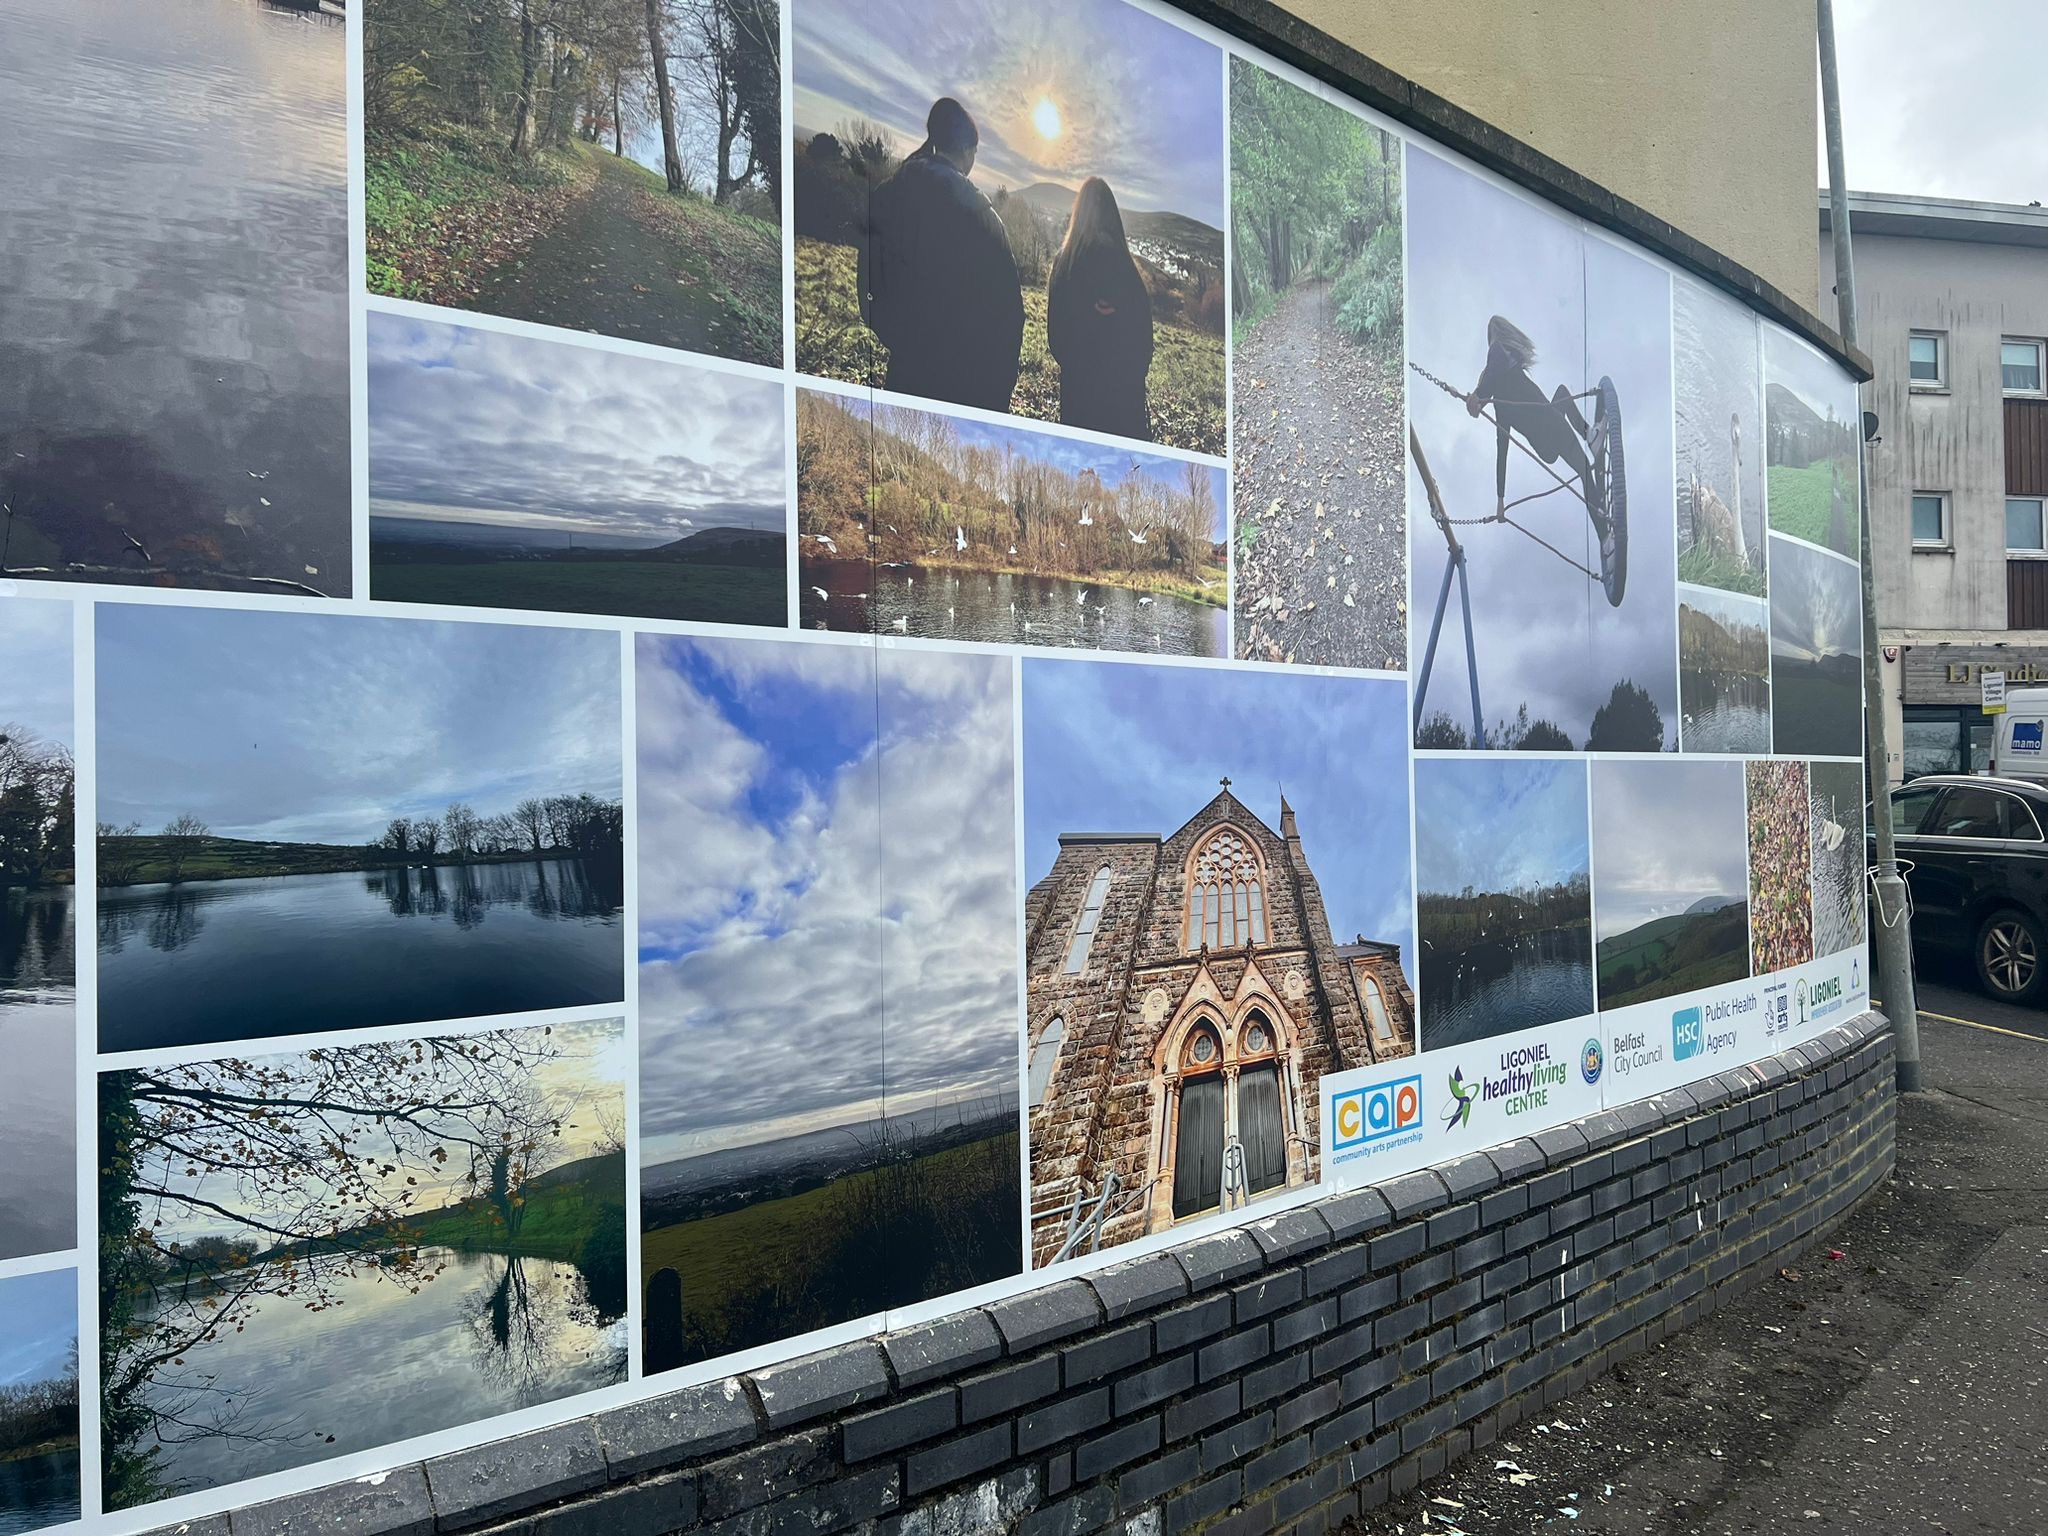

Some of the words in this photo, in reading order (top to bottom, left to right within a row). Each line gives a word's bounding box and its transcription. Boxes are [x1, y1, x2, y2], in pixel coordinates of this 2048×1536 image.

[1981, 663, 2048, 681] Sudio
[2012, 740, 2041, 749] mamo
[1810, 976, 1841, 1006] LIGONIEL
[1705, 1003, 1730, 1022] Public
[1732, 993, 1757, 1015] Health
[1614, 1032, 1645, 1054] Belfast
[1676, 1021, 1697, 1045] HSC
[1707, 1030, 1737, 1054] Agency
[1500, 1043, 1550, 1071] LIGONIEL
[1614, 1054, 1631, 1075] City
[1632, 1045, 1663, 1068] Council
[1338, 1086, 1417, 1138] cap
[1505, 1089, 1548, 1116] CENTRE
[1332, 1146, 1371, 1165] community
[1372, 1143, 1385, 1153] arts
[1386, 1132, 1423, 1152] partnership
